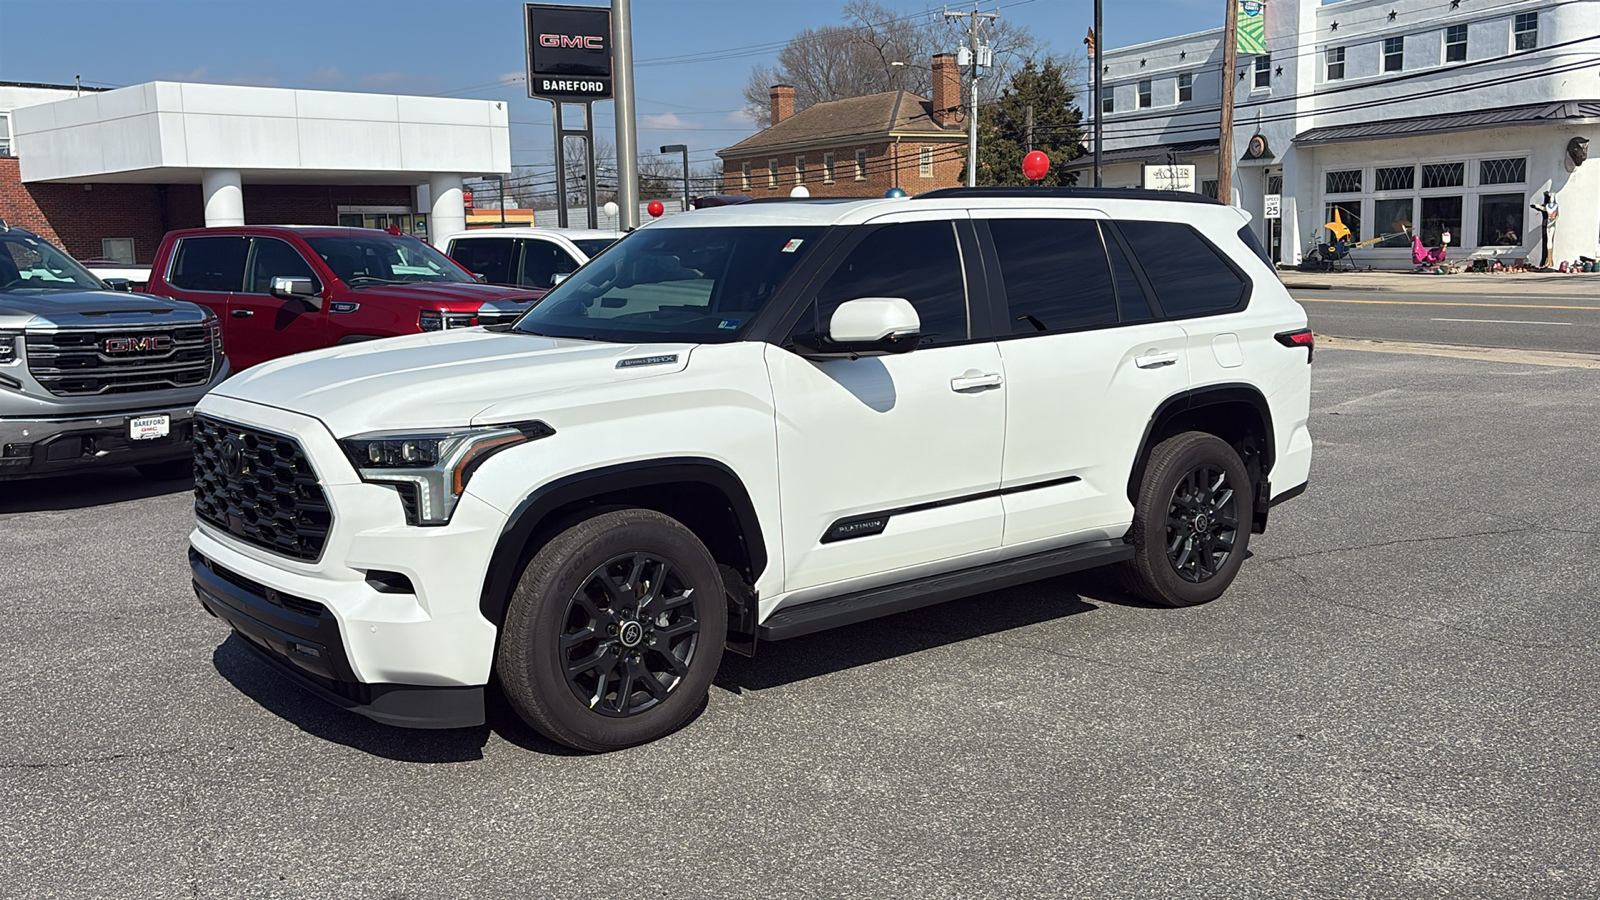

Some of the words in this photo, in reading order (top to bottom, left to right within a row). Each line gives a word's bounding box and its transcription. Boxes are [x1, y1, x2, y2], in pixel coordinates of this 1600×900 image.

[540, 34, 603, 49] GMC
[543, 80, 604, 91] BAREFORD
[1266, 206, 1279, 215] 25
[106, 336, 171, 352] GMC
[134, 419, 165, 427] BAREFORD
[839, 521, 880, 532] PLATINUM
